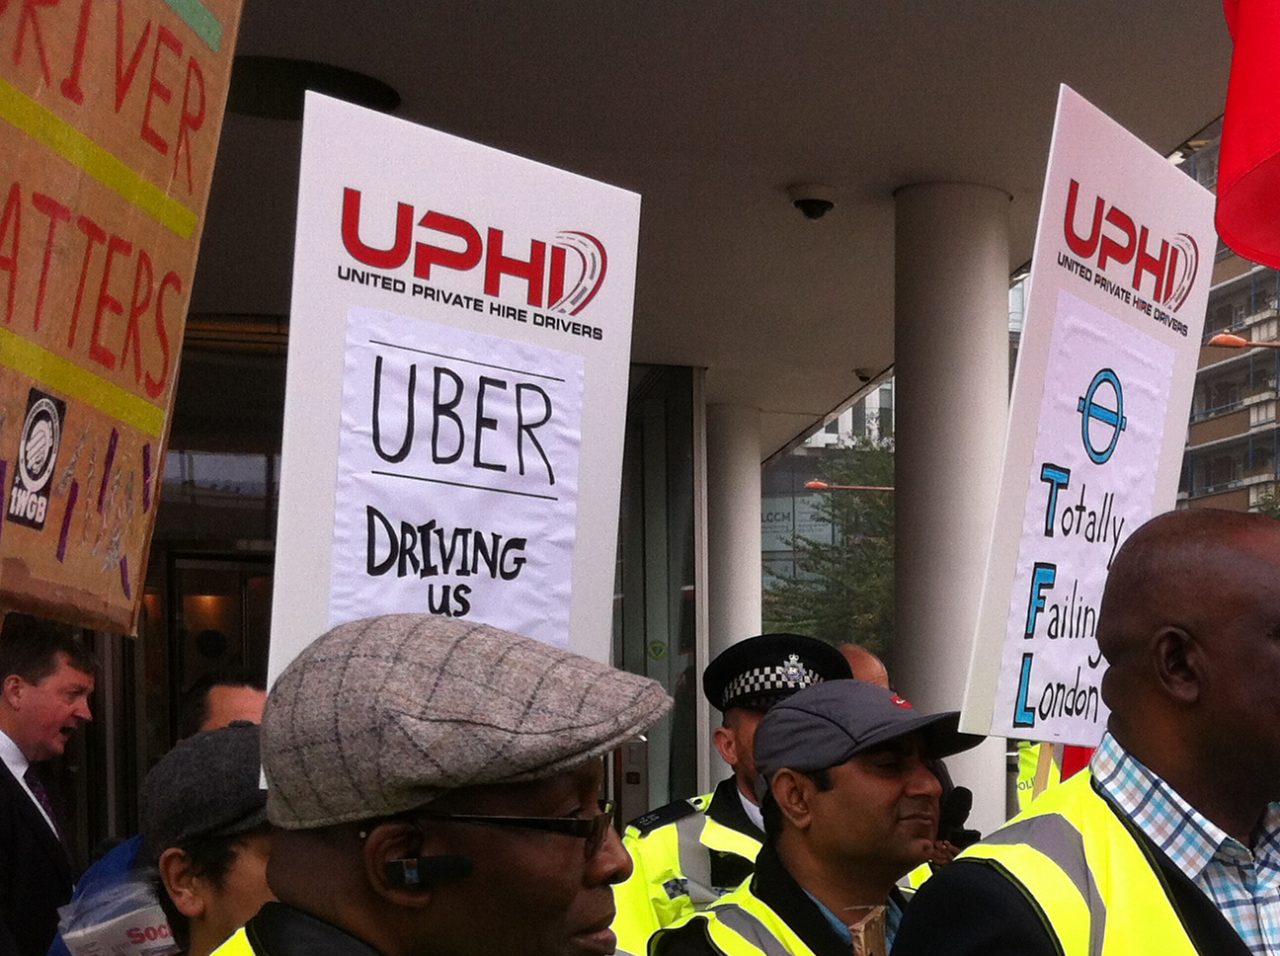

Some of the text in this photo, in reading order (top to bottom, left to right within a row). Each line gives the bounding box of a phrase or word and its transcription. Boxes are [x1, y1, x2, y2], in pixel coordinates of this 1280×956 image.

[0, 0, 207, 196] RIVER
[341, 186, 567, 310] UPHI
[1057, 251, 1189, 338] UNITED PRIVATE HIRE DRIVERS
[1064, 178, 1180, 305] UPHI
[337, 265, 604, 341] UNITED PRIVATE HIRE DRIVERS
[371, 354, 556, 486] UBER
[366, 504, 528, 581] DRIVING
[1040, 462, 1125, 571] Totally
[1012, 652, 1099, 729] London
